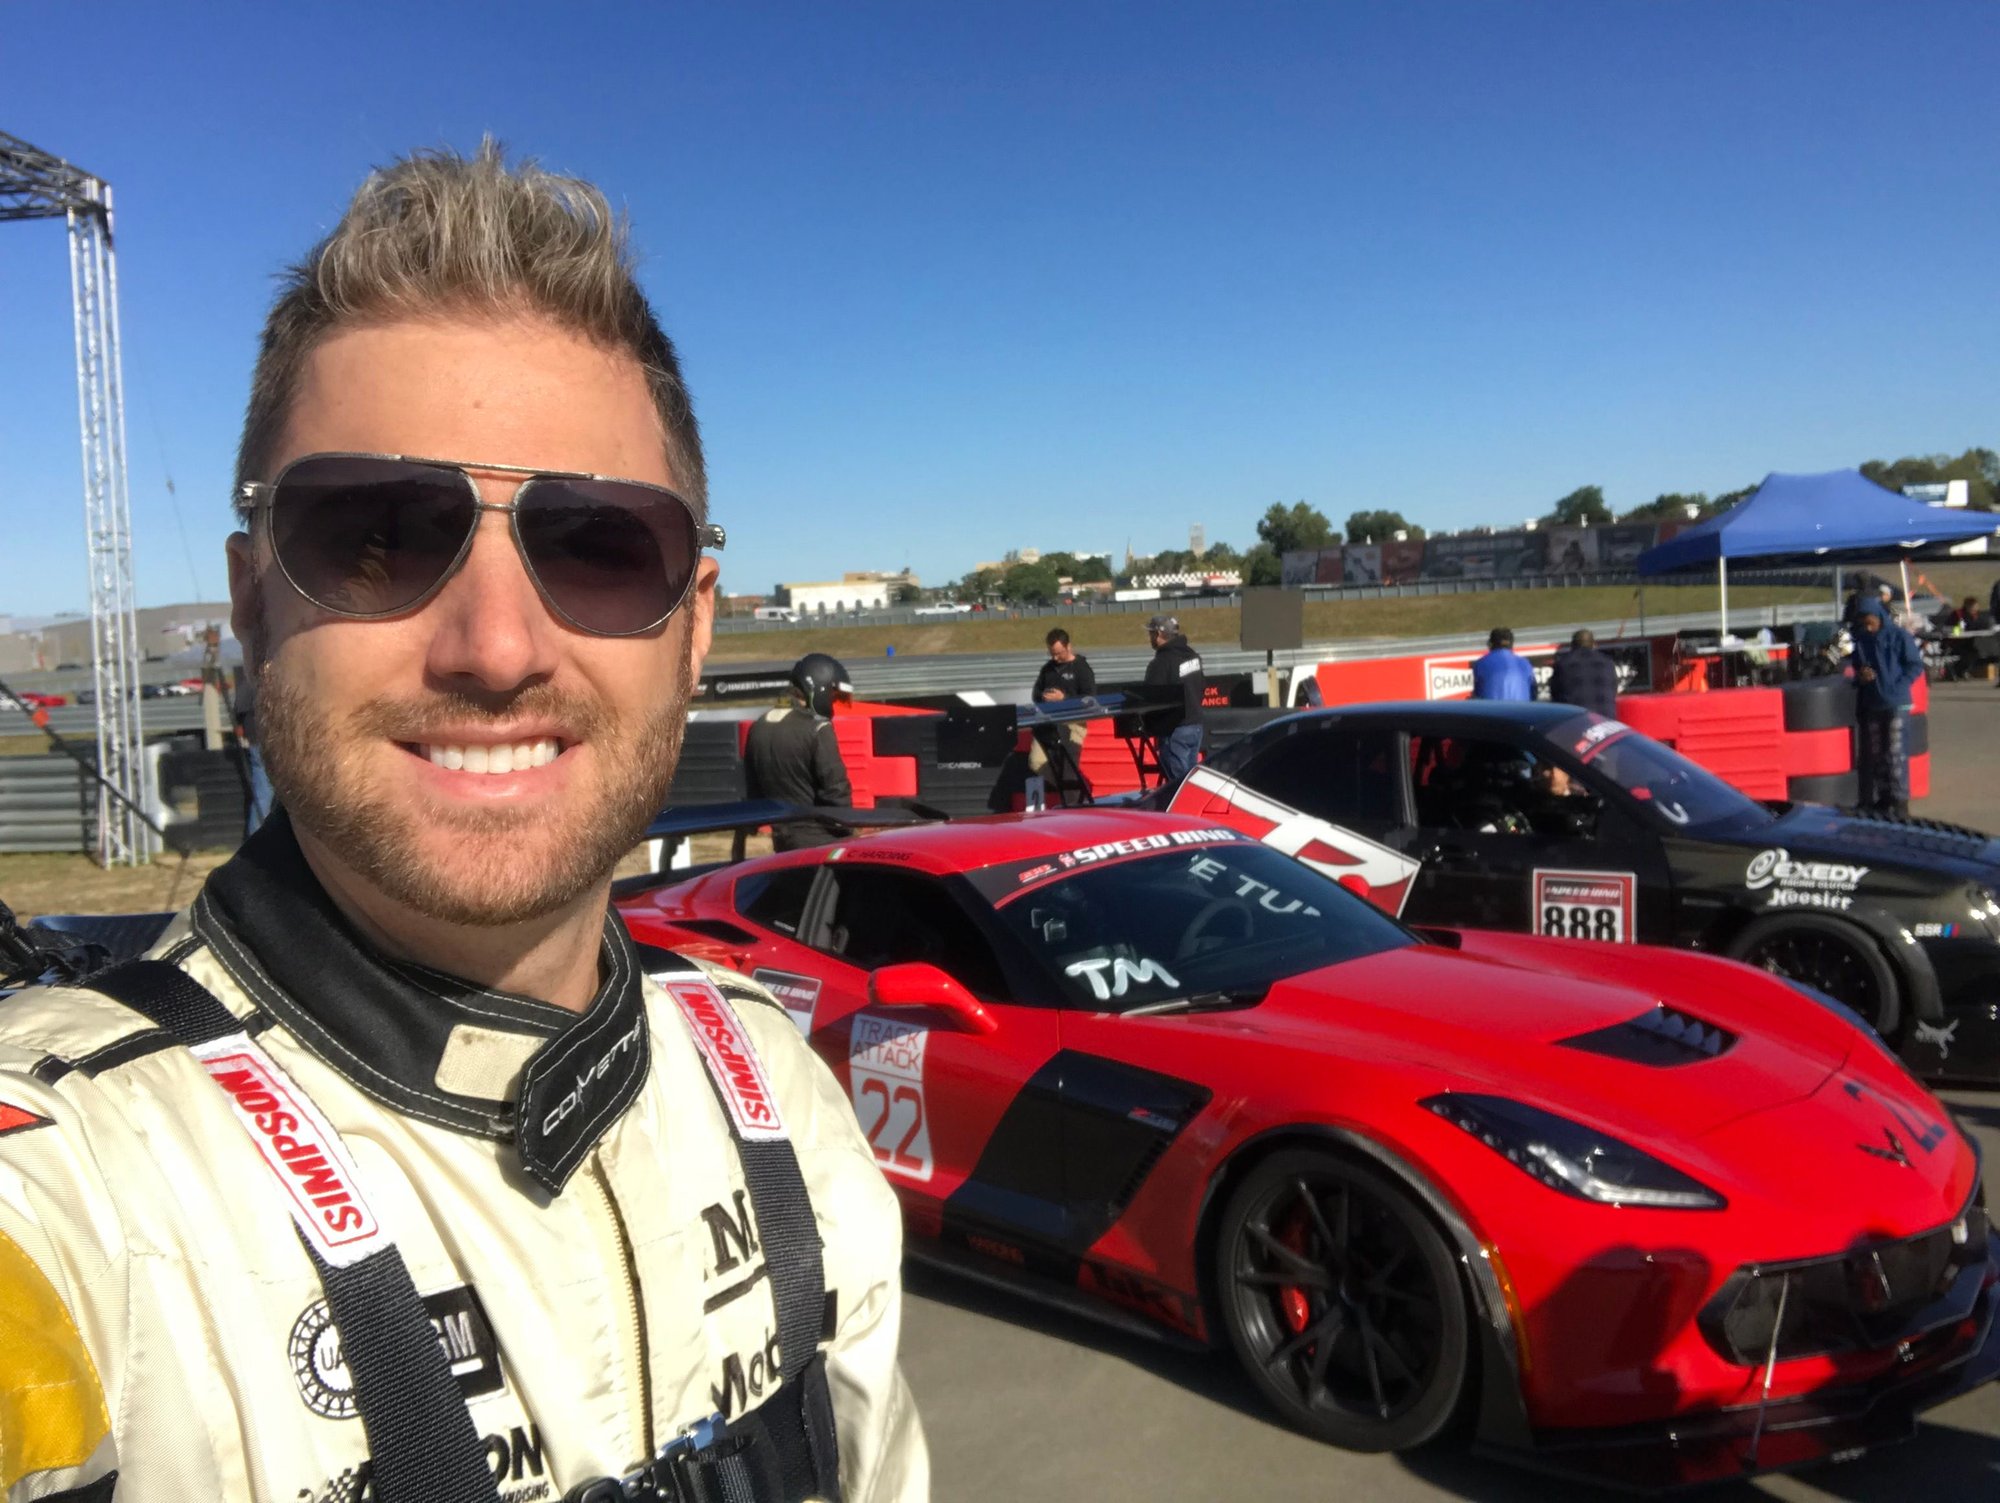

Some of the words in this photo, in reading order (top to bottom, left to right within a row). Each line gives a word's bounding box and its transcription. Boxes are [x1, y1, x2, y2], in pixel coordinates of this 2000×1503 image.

[1073, 834, 1170, 863] SPEED
[1170, 829, 1236, 845] RING
[1773, 860, 1870, 883] EXEDY
[1065, 957, 1180, 999] TM
[859, 1019, 921, 1050] TRACK
[679, 992, 771, 1122] SIMPSON
[853, 1041, 921, 1072] ATTACK
[862, 1078, 924, 1171] 22
[210, 1069, 363, 1232] SIMPSON
